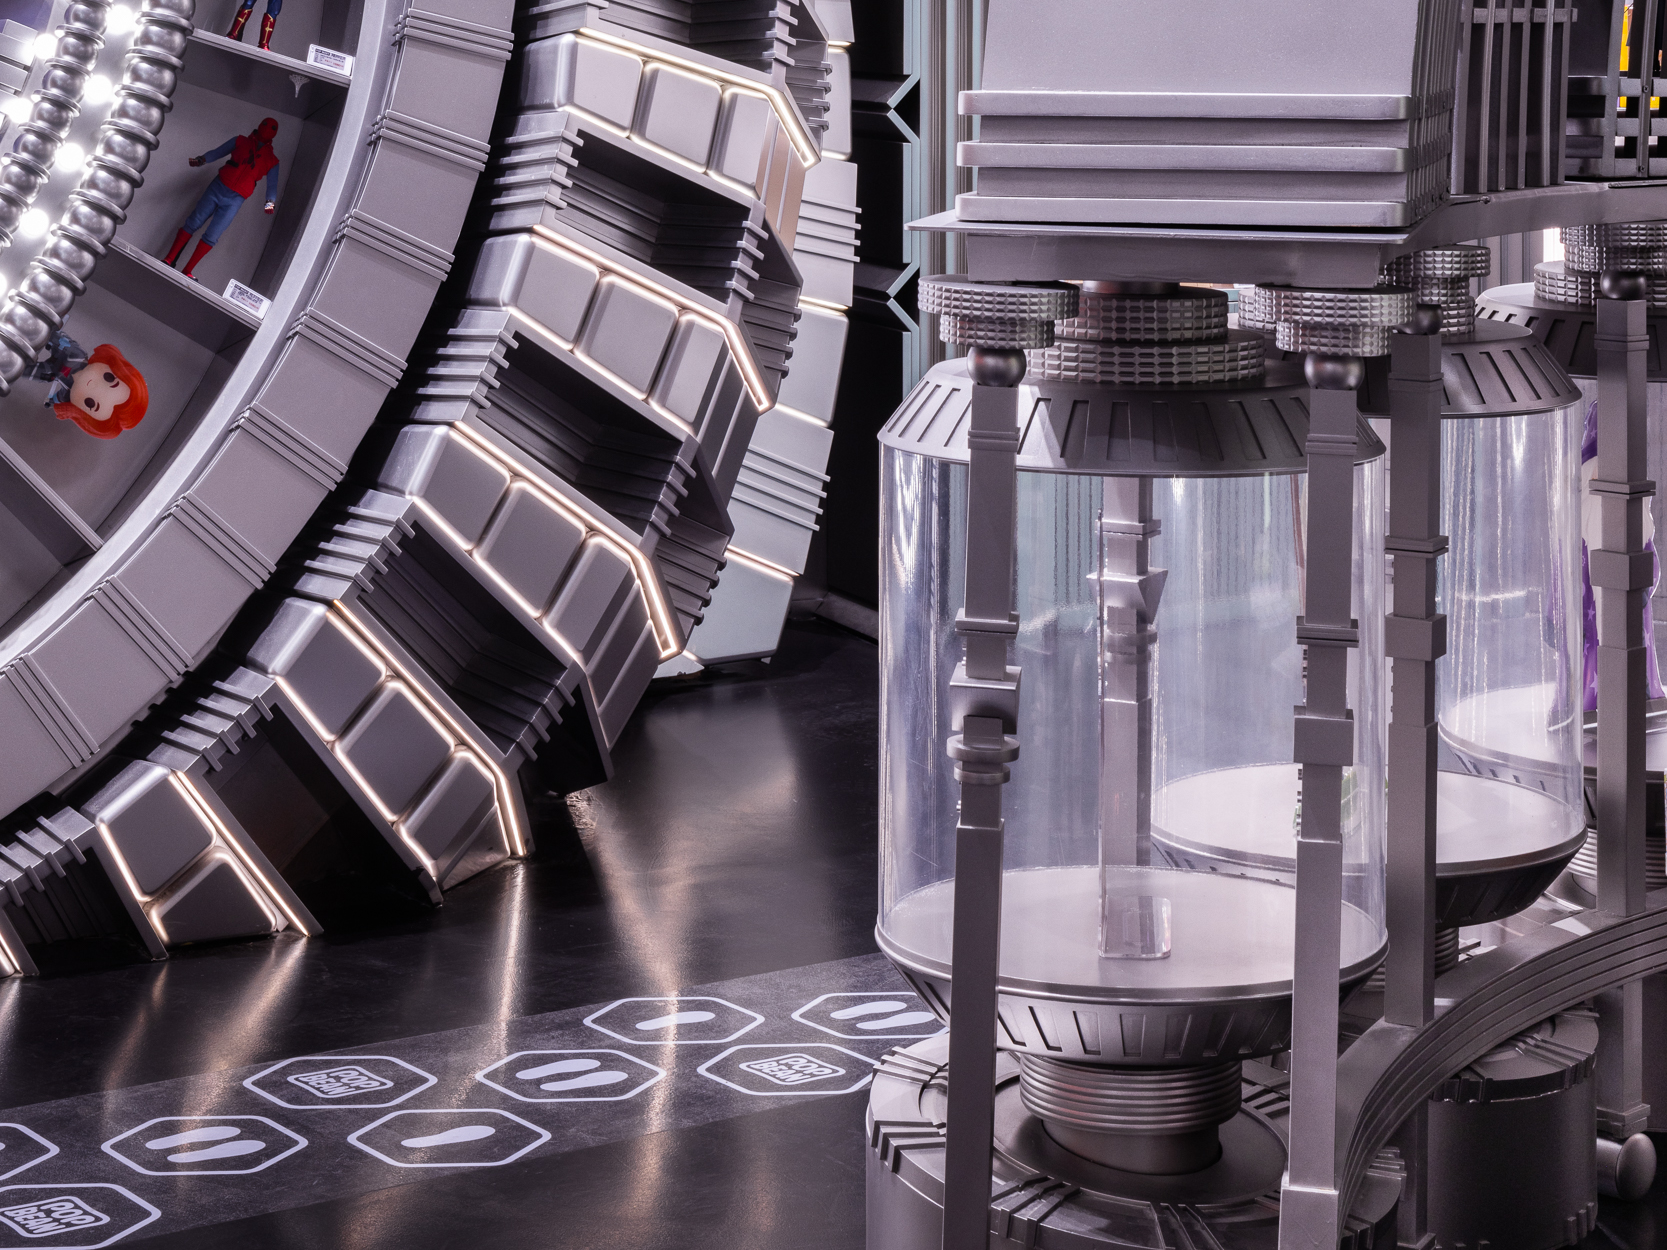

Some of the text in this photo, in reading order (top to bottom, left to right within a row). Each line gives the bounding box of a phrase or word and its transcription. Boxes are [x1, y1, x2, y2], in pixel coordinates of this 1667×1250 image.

[750, 1061, 811, 1082] BEAN
[779, 1057, 833, 1075] POP
[298, 1073, 356, 1095] BEAN
[329, 1070, 380, 1088] POP
[4, 1206, 66, 1234] BEAN
[40, 1202, 95, 1224] POP
